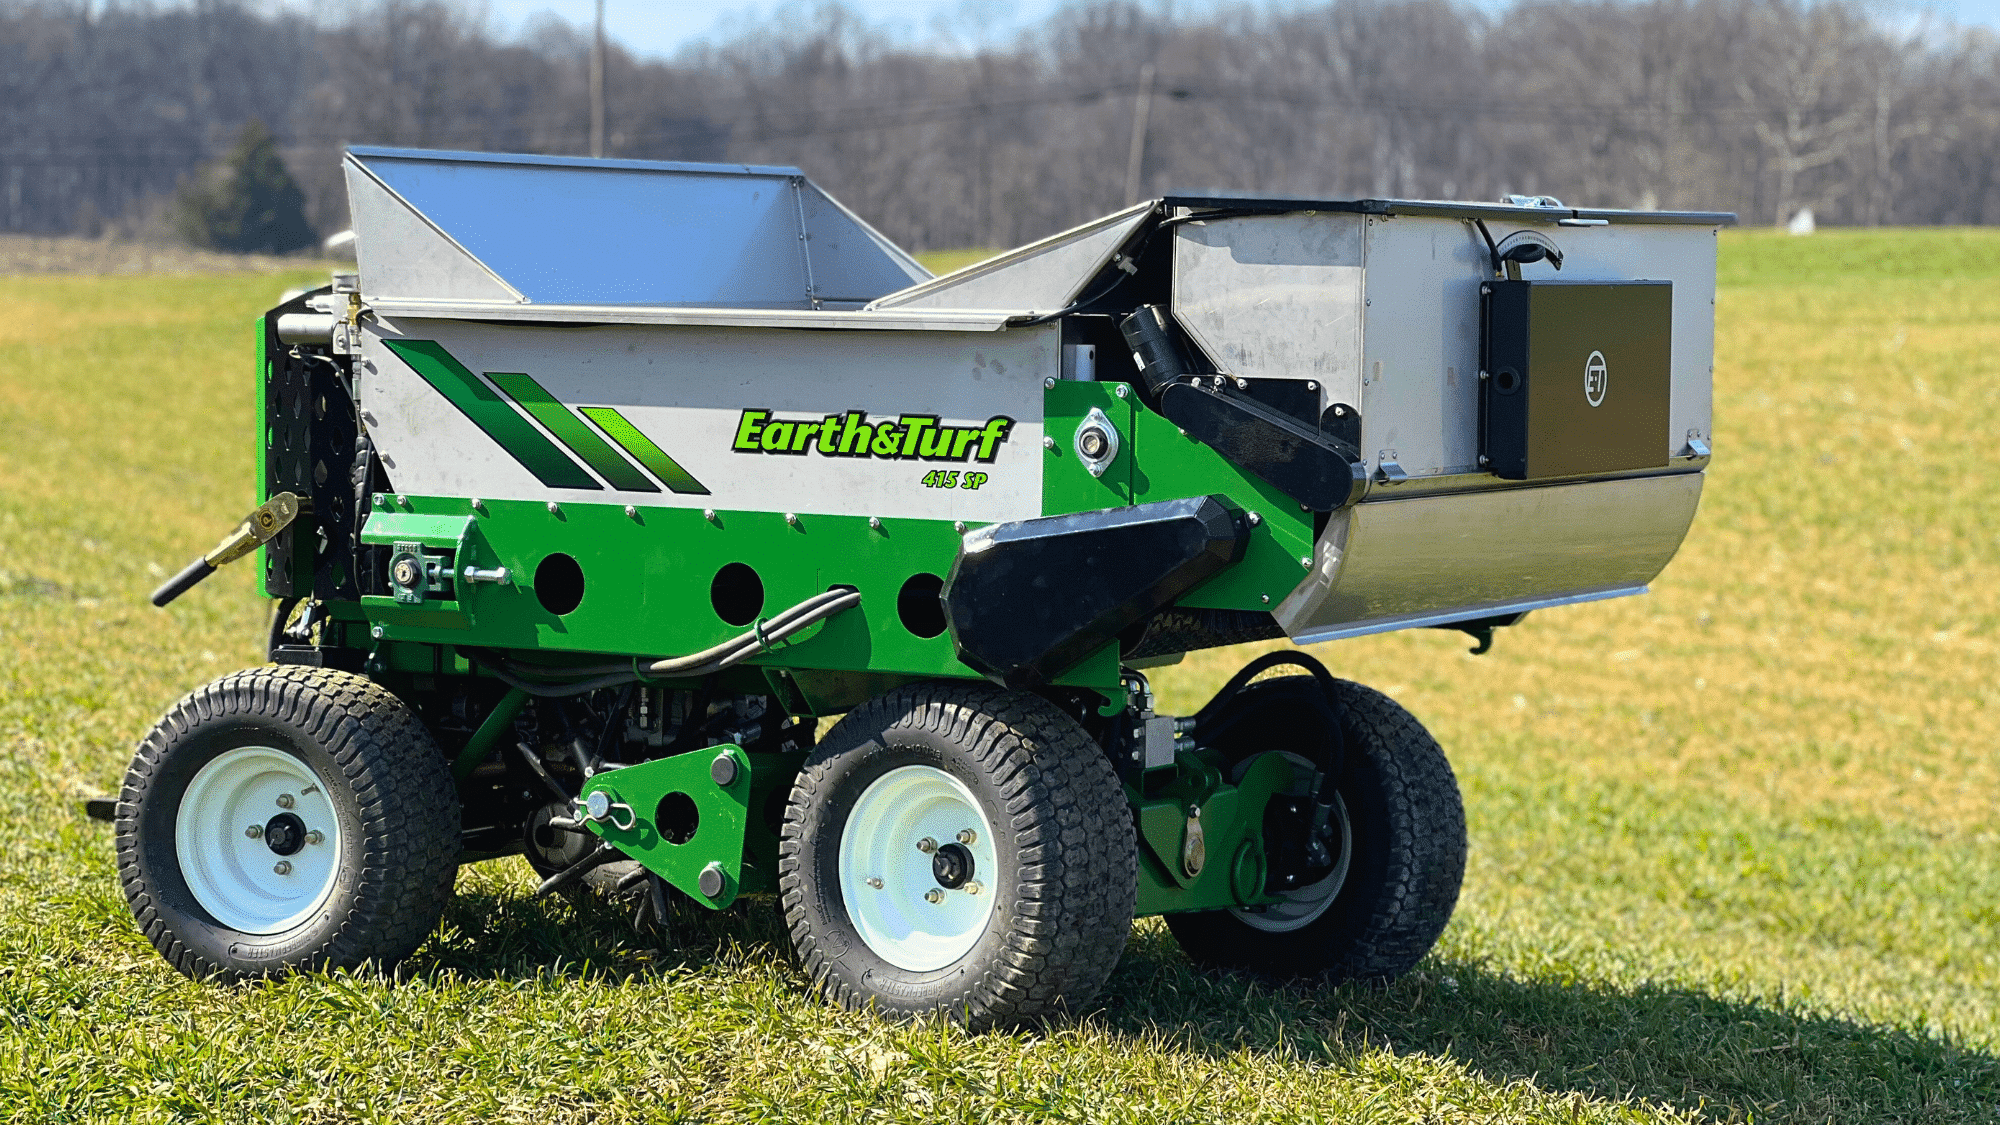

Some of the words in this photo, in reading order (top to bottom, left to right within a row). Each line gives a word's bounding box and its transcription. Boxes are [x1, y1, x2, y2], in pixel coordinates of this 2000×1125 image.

[731, 408, 1016, 464] Earth&Turf
[921, 470, 958, 490] 415
[961, 472, 989, 491] SP
